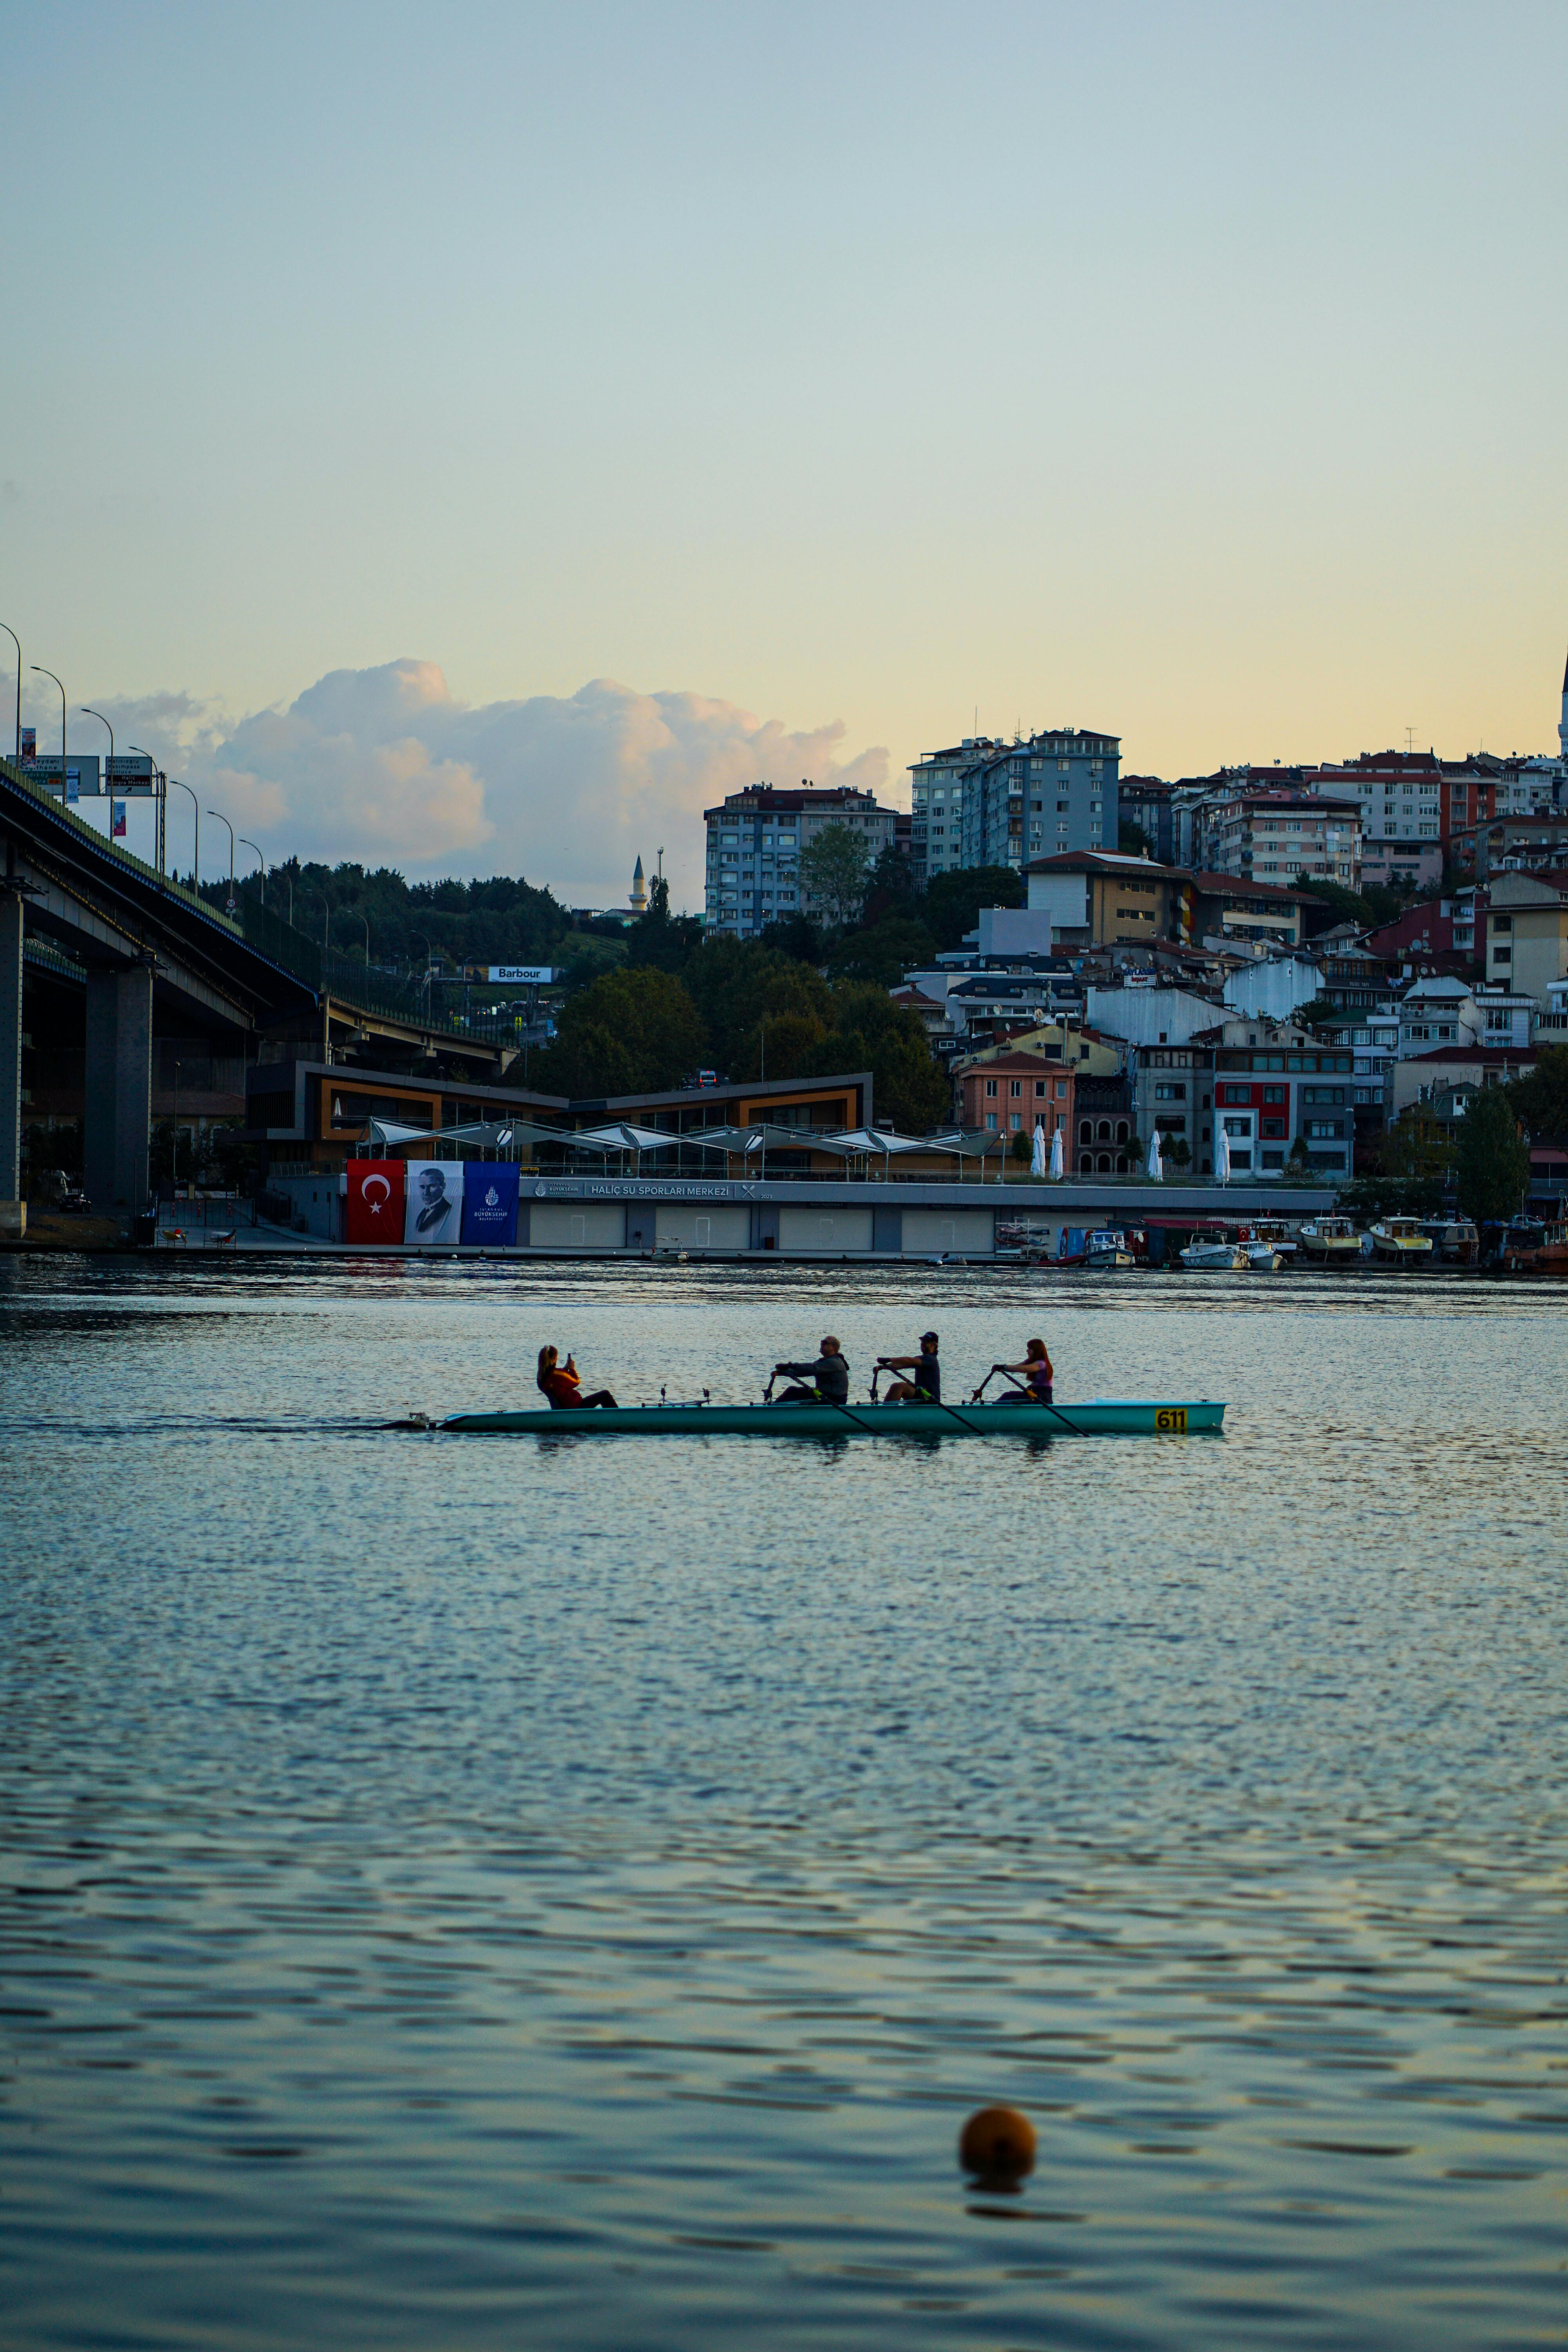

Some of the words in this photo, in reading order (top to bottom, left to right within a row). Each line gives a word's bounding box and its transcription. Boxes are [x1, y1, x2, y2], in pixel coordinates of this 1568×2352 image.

[499, 969, 540, 978] Barbour
[592, 1185, 620, 1195] HALİÇ
[687, 1187, 729, 1196] MERKEZİ
[1158, 1411, 1184, 1427] 611
